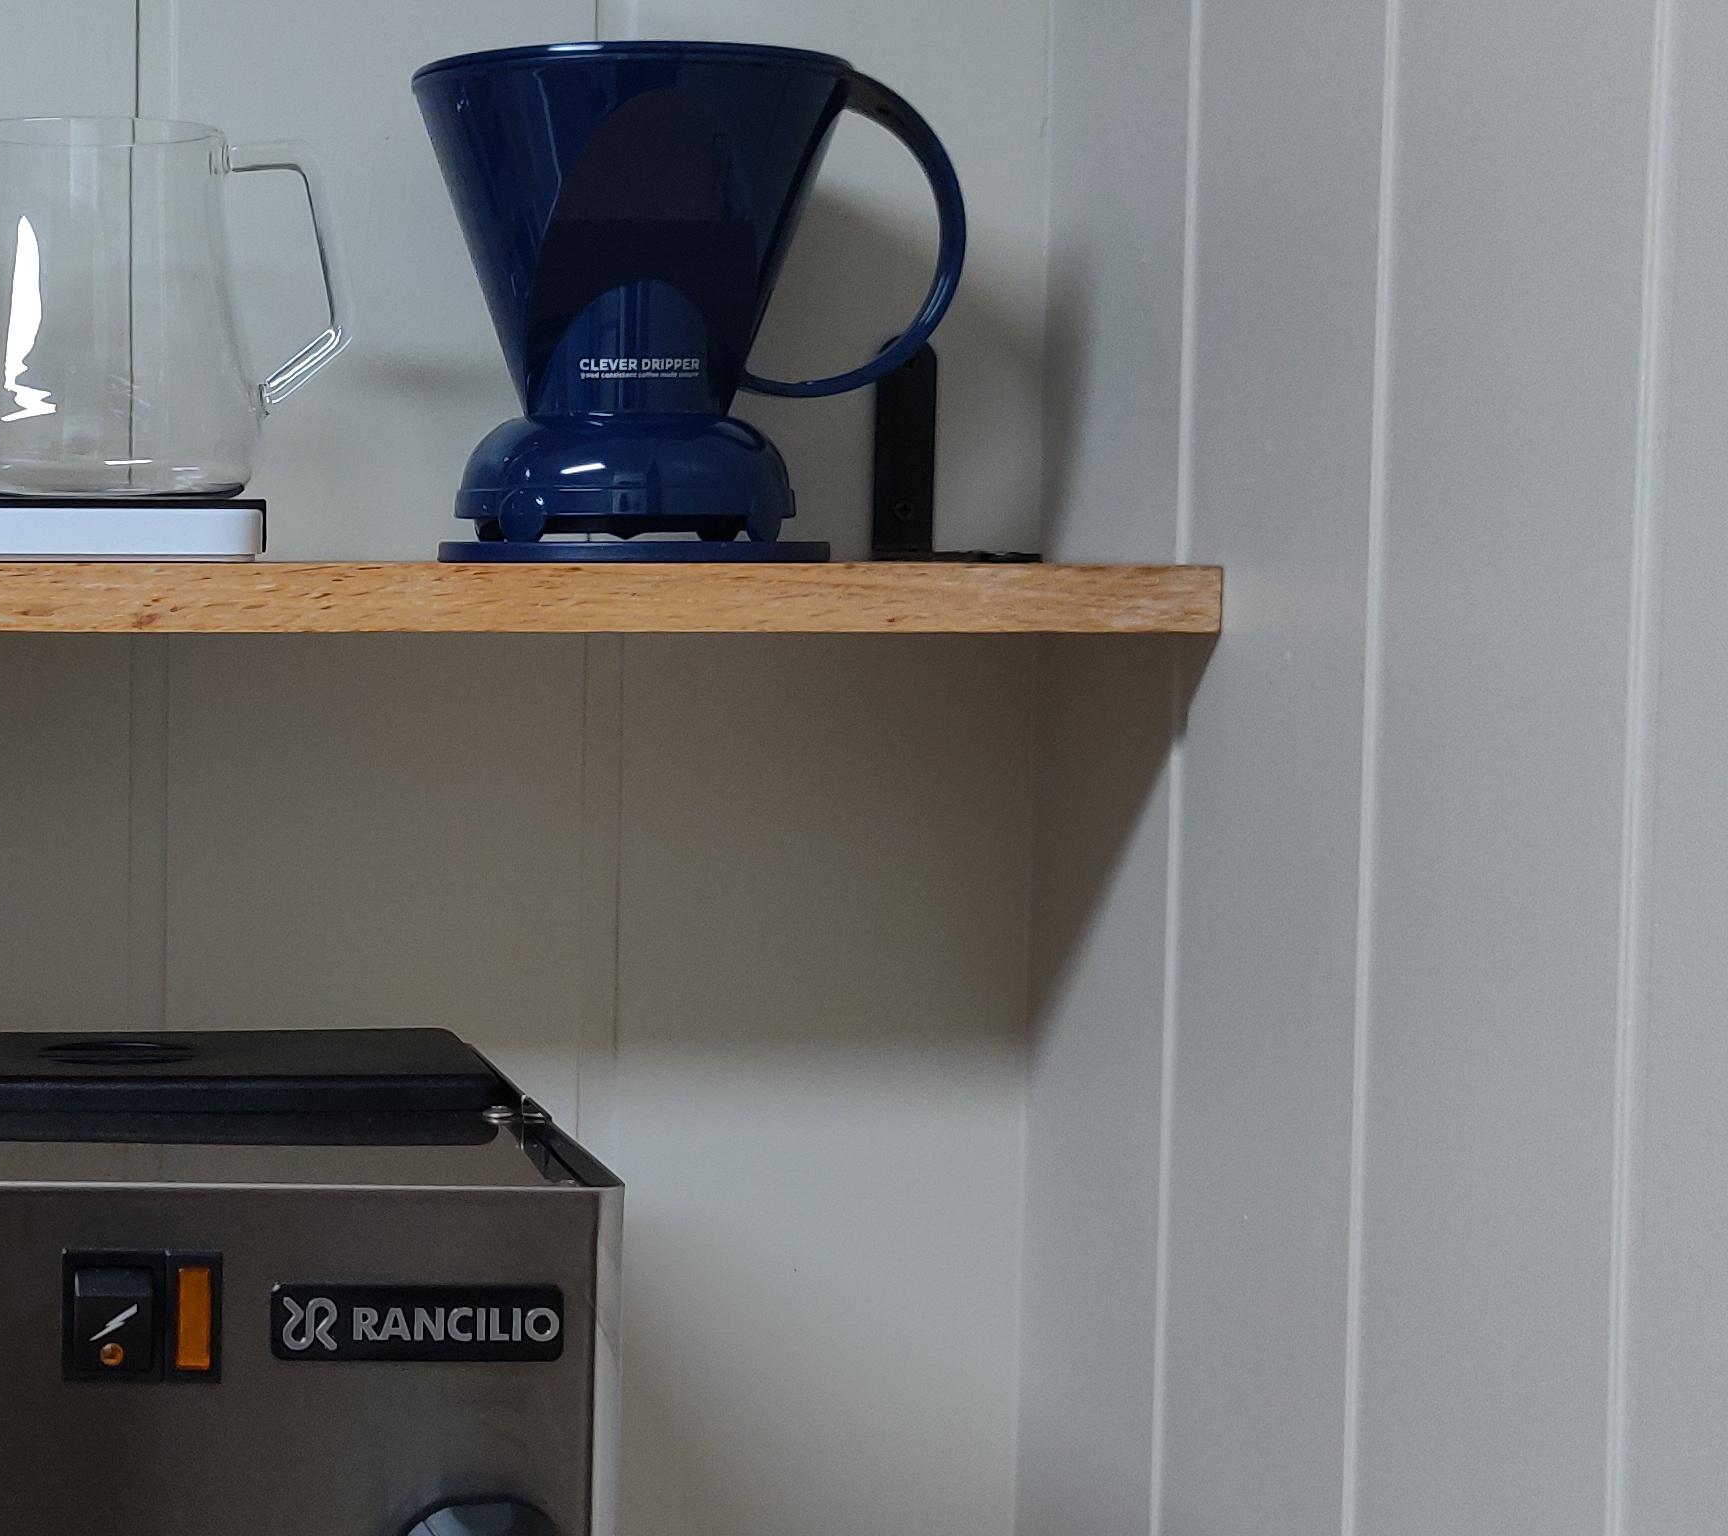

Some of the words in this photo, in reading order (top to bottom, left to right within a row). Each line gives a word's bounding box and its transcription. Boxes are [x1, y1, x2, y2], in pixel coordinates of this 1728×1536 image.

[579, 358, 638, 371] CLEVER
[641, 358, 700, 370] DRIPPER
[353, 1307, 559, 1341] RANCILIO
